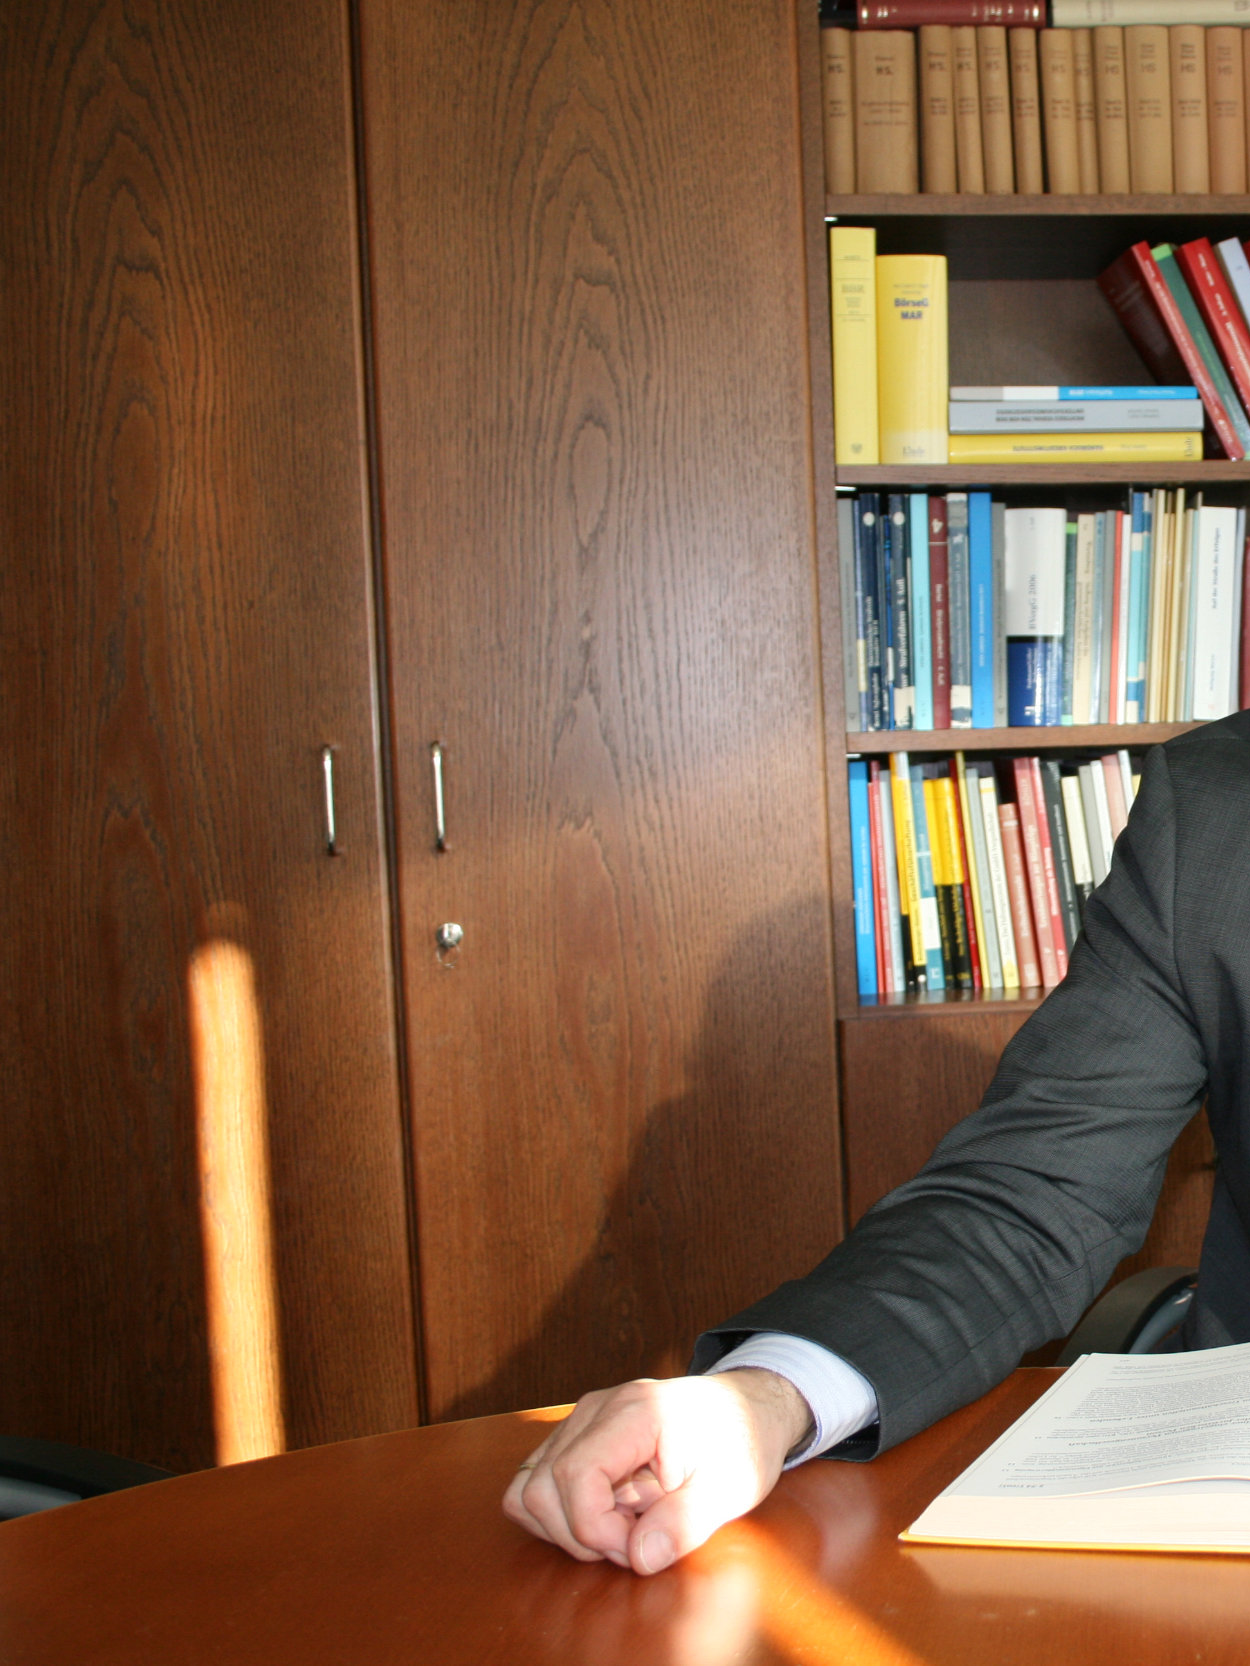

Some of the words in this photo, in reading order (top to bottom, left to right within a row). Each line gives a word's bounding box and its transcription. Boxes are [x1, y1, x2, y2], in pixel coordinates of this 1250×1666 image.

[894, 298, 929, 308] BörseG
[901, 311, 923, 320] MAR
[932, 518, 943, 534] 4
[1028, 574, 1036, 596] 2006
